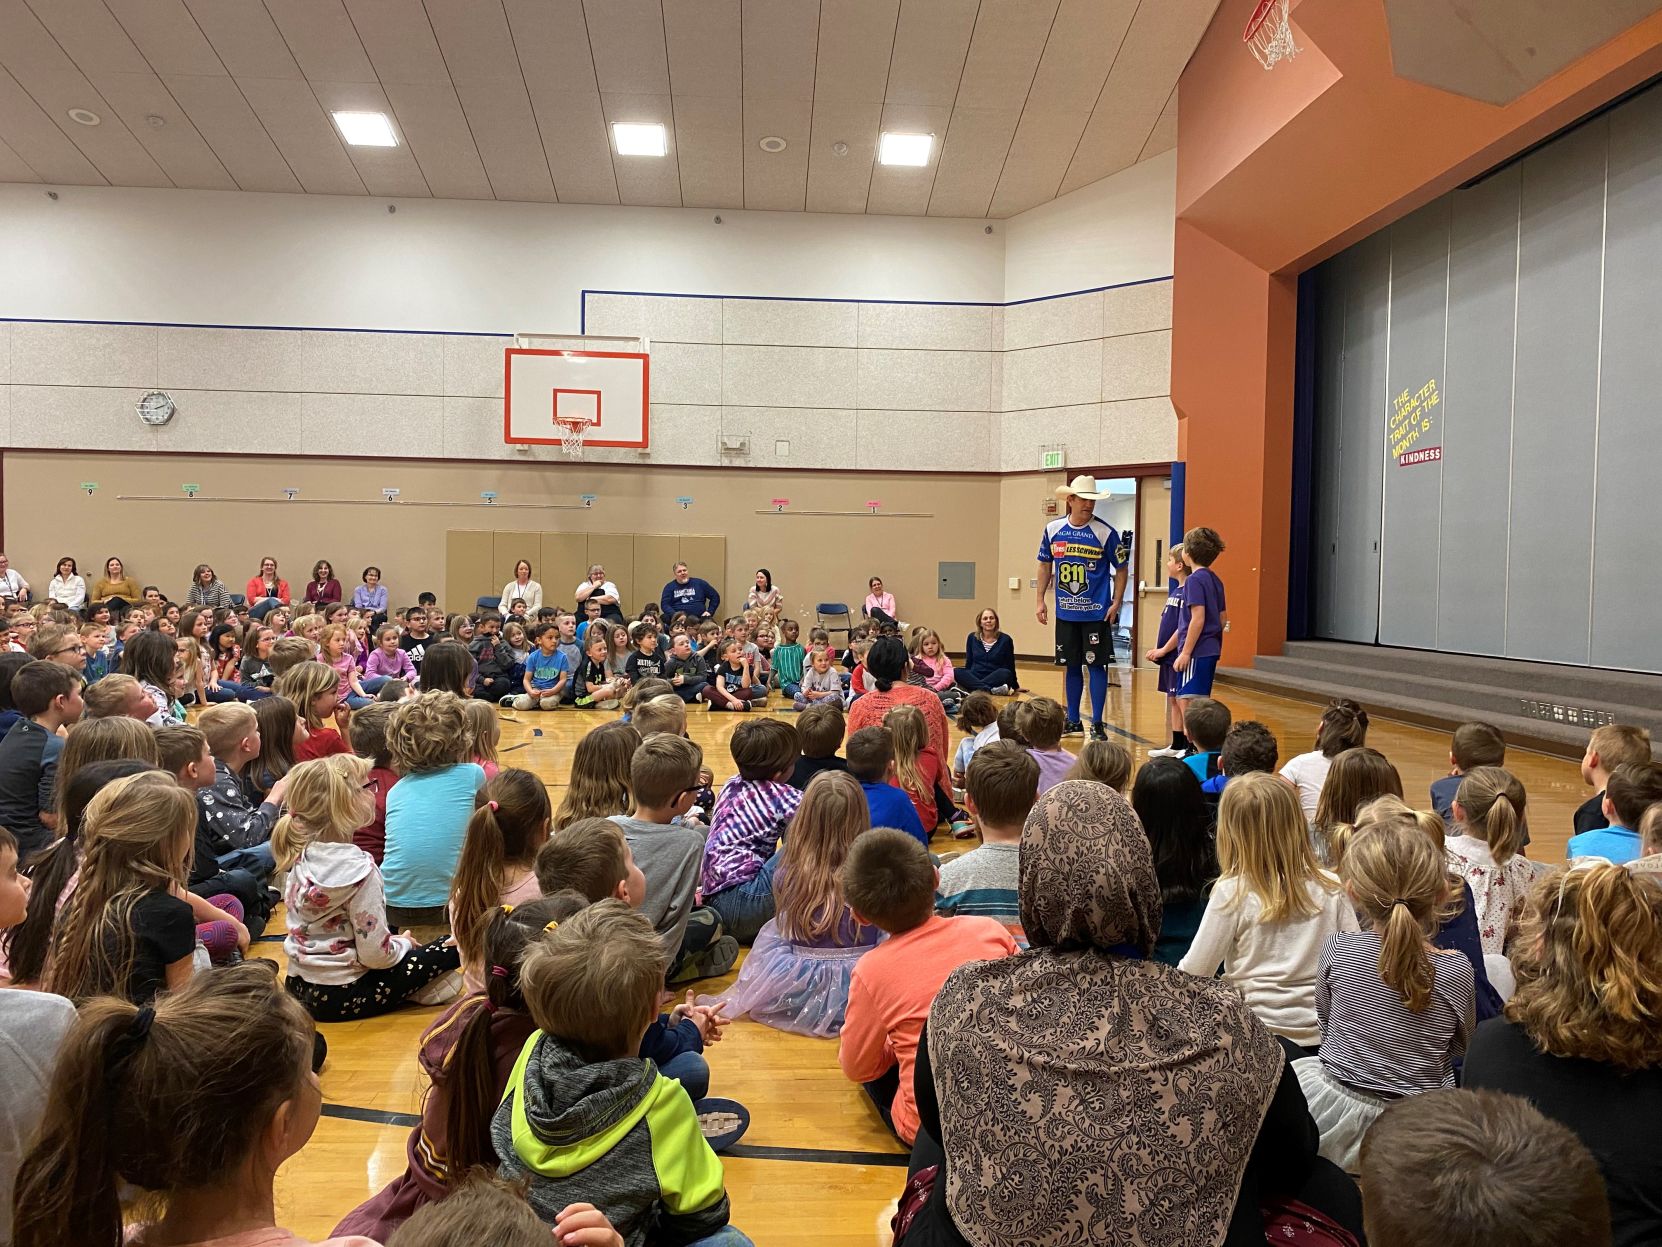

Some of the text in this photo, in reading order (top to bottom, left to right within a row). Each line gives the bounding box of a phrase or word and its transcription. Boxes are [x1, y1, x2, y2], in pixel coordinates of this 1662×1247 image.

[1390, 379, 1436, 429] CHARACTER
[1393, 388, 1410, 410] THE
[1390, 390, 1440, 445] TRAIT OF THE
[1392, 428, 1420, 459] MONTH
[1045, 453, 1060, 466] EXIT
[1400, 448, 1441, 464] KINDNESS
[1072, 531, 1094, 539] GRAND
[1060, 563, 1085, 584] 811
